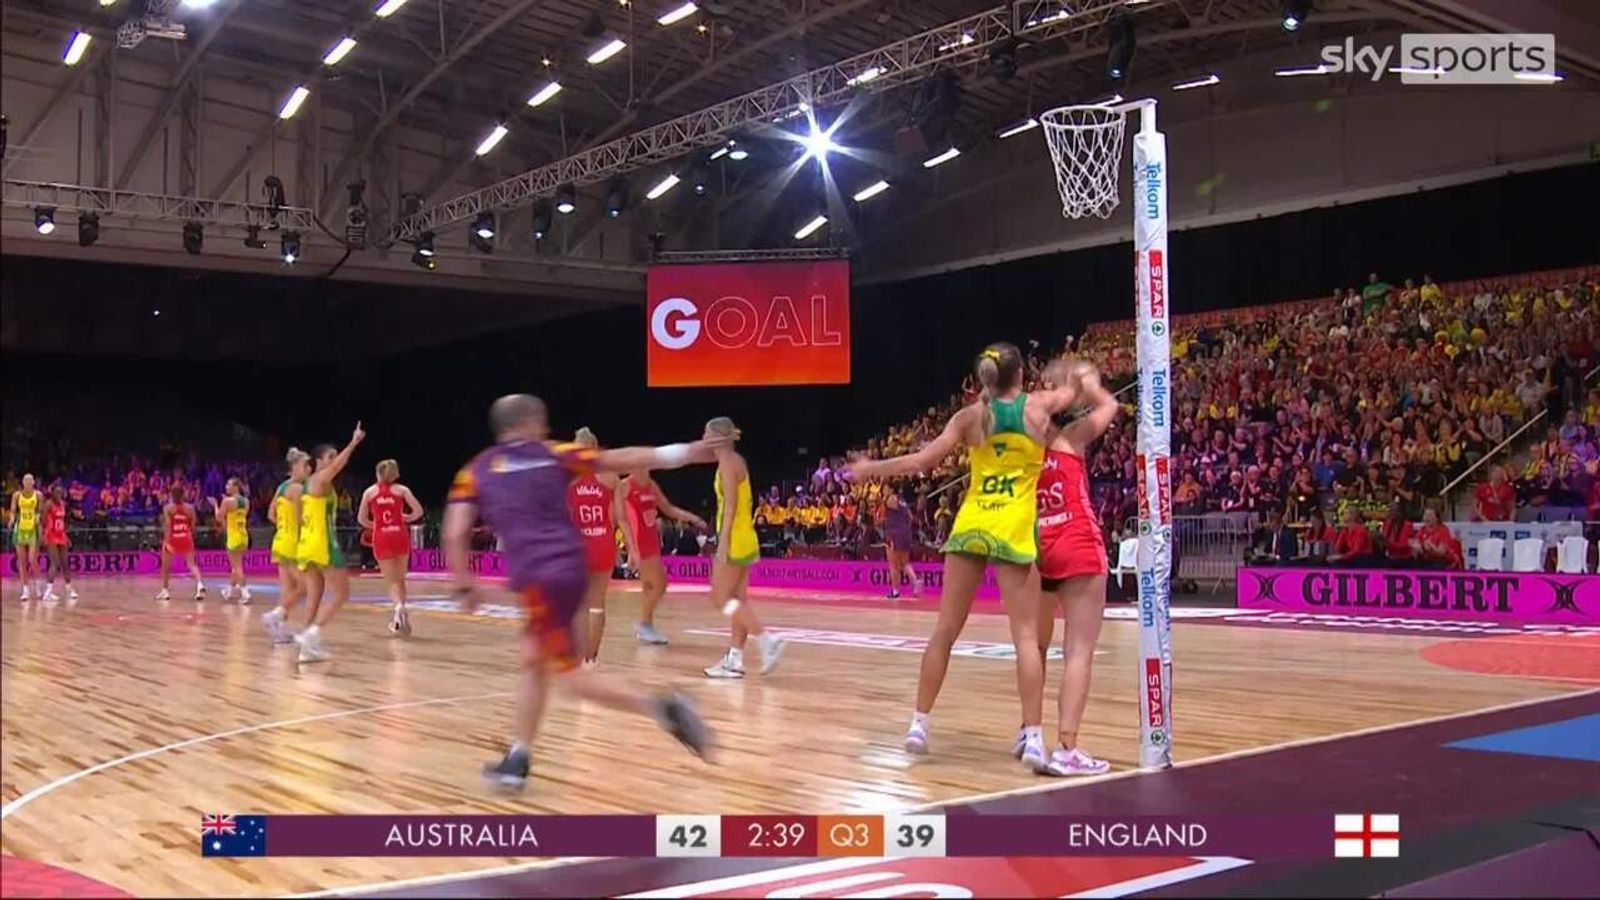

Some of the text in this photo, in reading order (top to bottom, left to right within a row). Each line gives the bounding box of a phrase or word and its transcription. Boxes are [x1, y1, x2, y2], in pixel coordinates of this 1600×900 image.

[1147, 161, 1162, 219] Telkom
[1150, 265, 1163, 317] SPAR
[651, 295, 841, 349] GOAL
[1152, 369, 1166, 427] Telkom
[383, 510, 392, 524] C
[580, 505, 603, 522] GA
[1141, 567, 1154, 627] Telkom
[1302, 572, 1519, 612] GILBERT
[1149, 674, 1162, 726] SPAR
